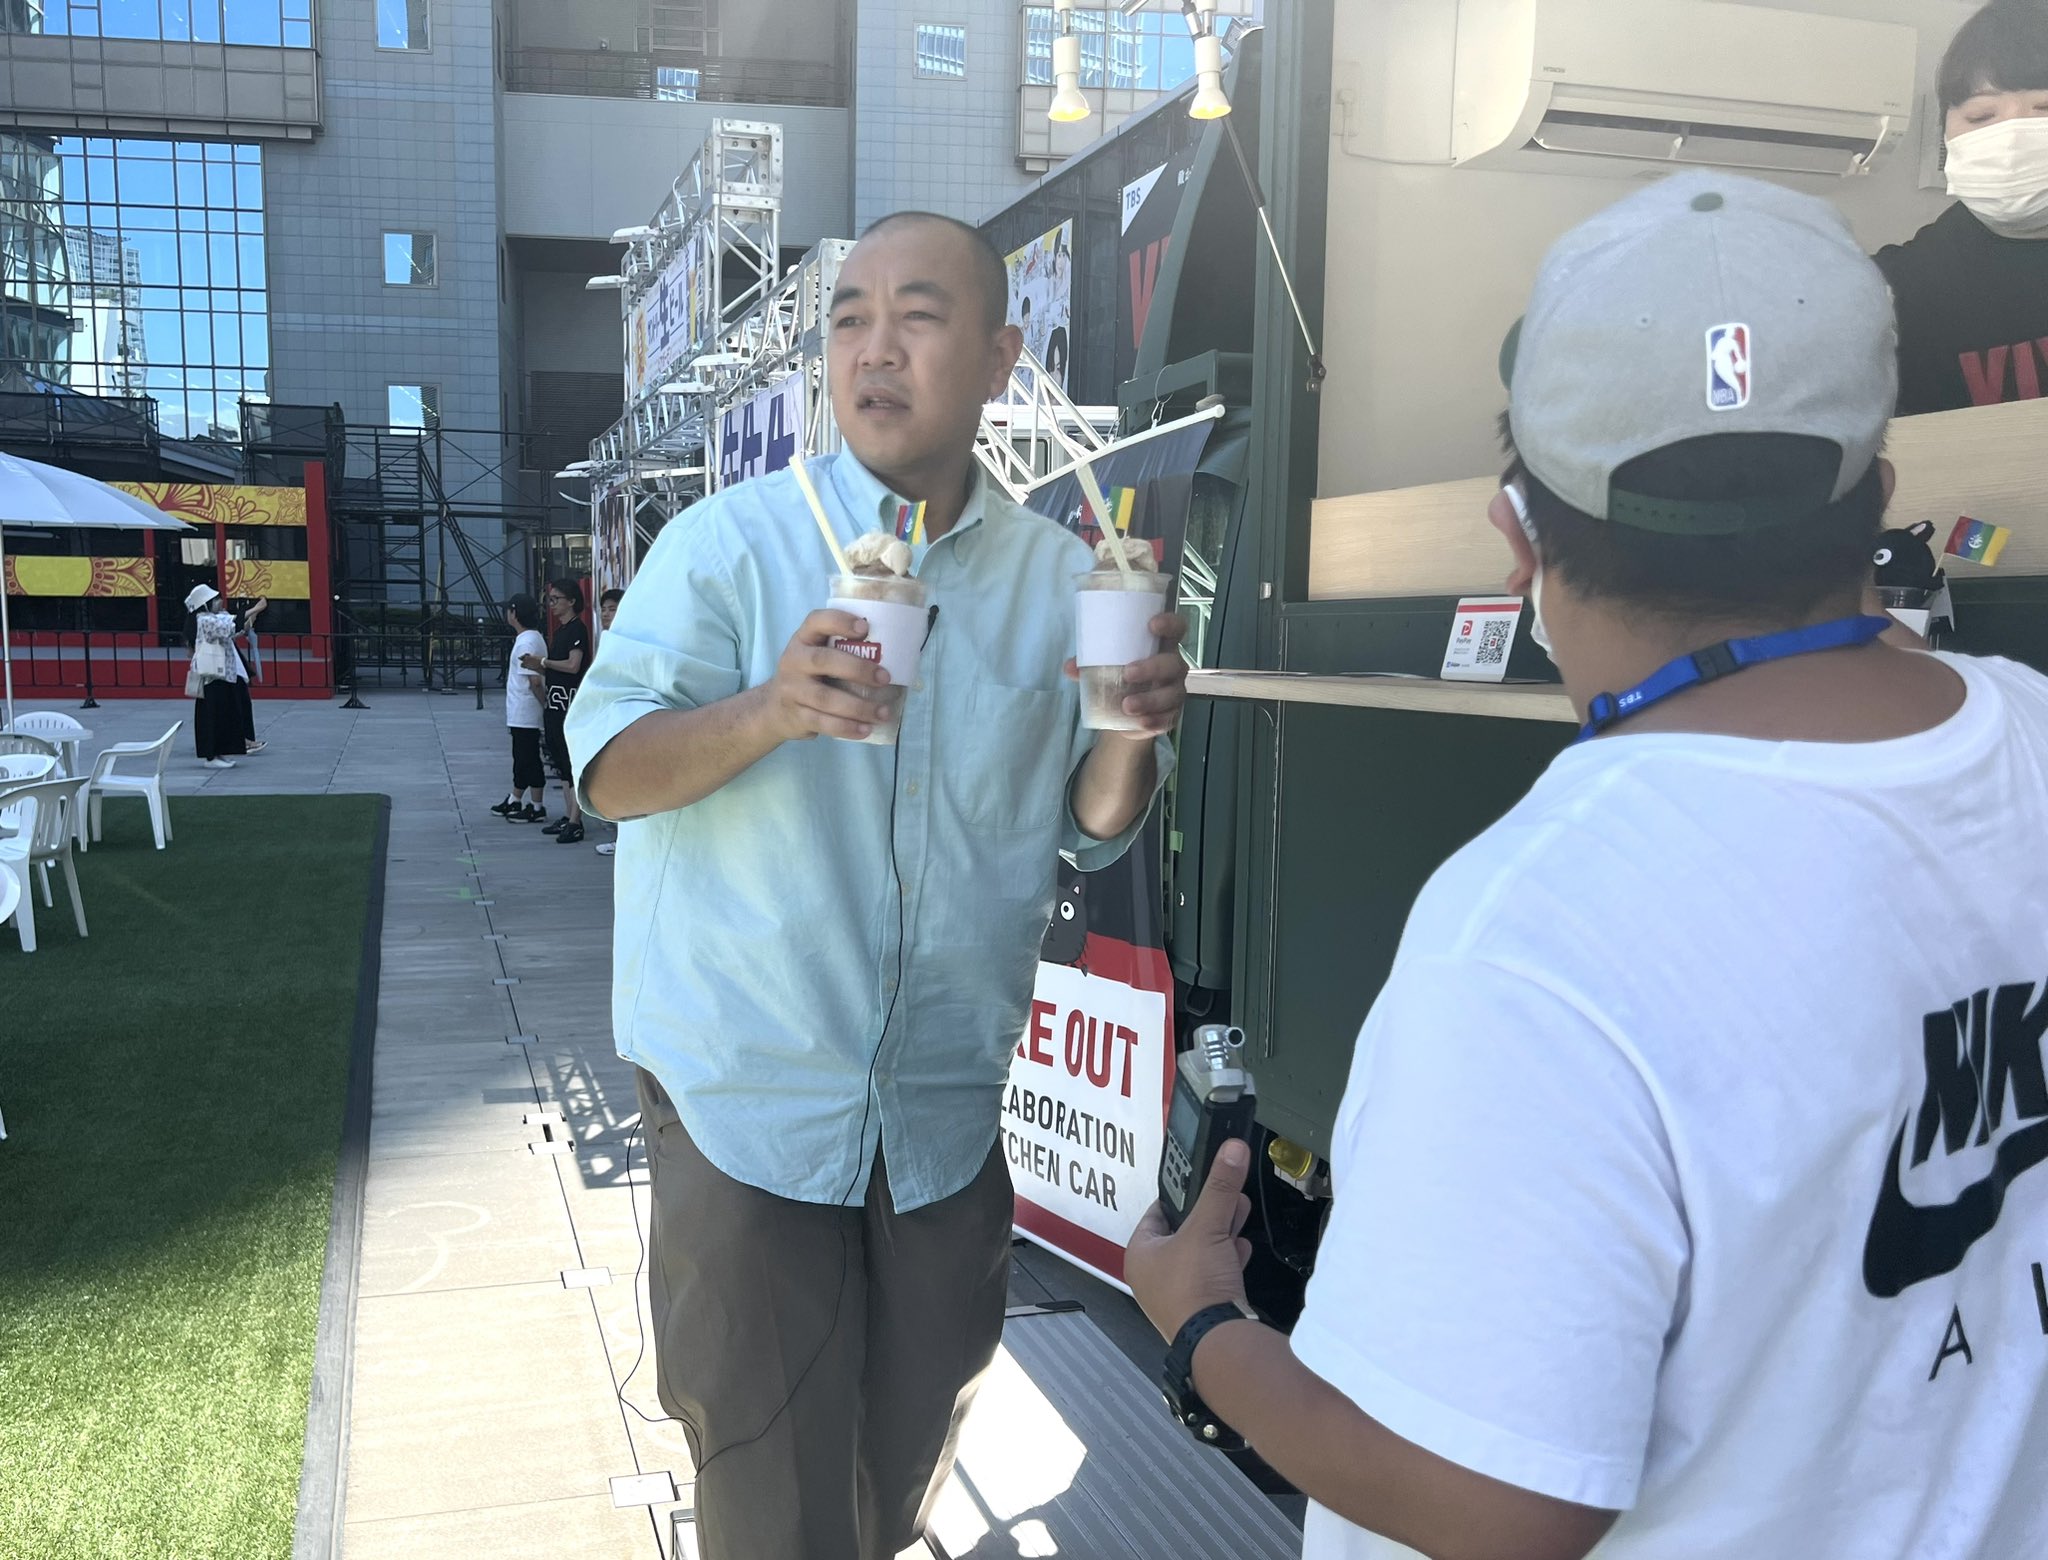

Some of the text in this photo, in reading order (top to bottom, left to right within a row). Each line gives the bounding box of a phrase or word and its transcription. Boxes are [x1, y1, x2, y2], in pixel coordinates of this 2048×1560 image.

[1126, 187, 1141, 211] TBS
[1713, 388, 1735, 404] NBA
[1959, 336, 2048, 406] VI
[1618, 691, 1642, 707] TBS
[1016, 999, 1138, 1098] E OUT
[1001, 1084, 1135, 1168] ABORATION
[1069, 1160, 1118, 1212] CAR
